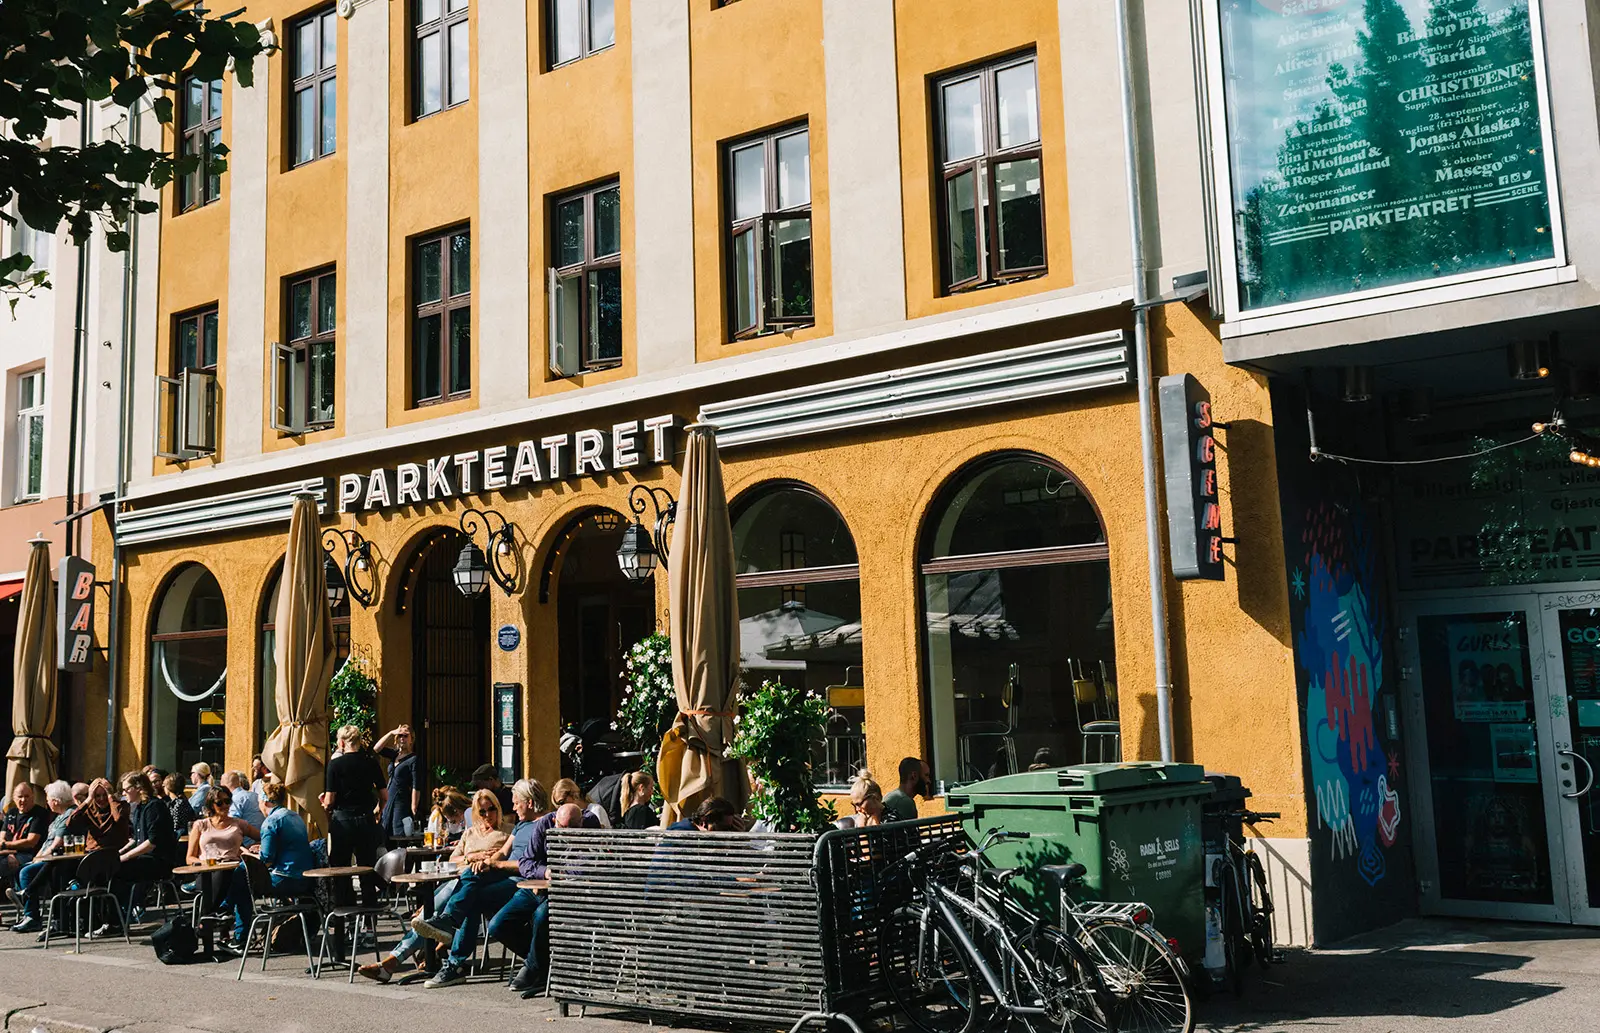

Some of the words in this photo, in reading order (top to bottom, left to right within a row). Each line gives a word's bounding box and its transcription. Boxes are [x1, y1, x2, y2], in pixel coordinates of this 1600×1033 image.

[1387, 54, 1400, 64] 20.
[1402, 44, 1453, 61] september
[1467, 21, 1528, 45] Slippkonsert
[1396, 23, 1457, 46] Bihop
[1274, 55, 1322, 76] Alfred
[1427, 44, 1487, 67] Farida
[1397, 62, 1525, 104] CHRISTEENE
[1425, 73, 1440, 83] 22.
[1441, 62, 1494, 80] september
[1328, 99, 1368, 118] Than
[1404, 100, 1430, 112] Supp:
[1432, 81, 1519, 105] Whalesharkattacks
[1351, 108, 1369, 119] (UK)
[1399, 123, 1435, 138] Yngling
[1436, 118, 1453, 131] (fri
[1454, 112, 1485, 127] alder)
[1495, 105, 1517, 117] over
[1518, 101, 1530, 111] 18
[1428, 112, 1443, 121] 28.
[1445, 101, 1498, 118] september
[1303, 138, 1371, 160] Furubotn,
[1306, 133, 1353, 148] september
[1406, 130, 1457, 154] Jonas
[1459, 117, 1521, 140] Alaska
[1418, 143, 1461, 156] m/David
[1462, 130, 1514, 148] Wallumrød
[1266, 161, 1310, 182] Slfrid
[1312, 149, 1367, 171] Molland
[1367, 146, 1383, 158] &
[1292, 170, 1333, 188] Roger
[1334, 156, 1391, 179] Aadland
[1434, 161, 1503, 183] Masego
[1501, 153, 1519, 165] (US)
[1442, 159, 1452, 168] 3.
[1453, 152, 1494, 166] oktober
[1277, 189, 1376, 218] Zeromancer
[1309, 184, 1358, 200] september
[1330, 194, 1472, 235] PARKTEATRET
[1511, 184, 1540, 196] SCENE
[339, 413, 674, 514] PARKTEATRET
[1194, 401, 1221, 563] SCENE
[69, 571, 94, 664] BAR
[1139, 842, 1157, 857] RAGN
[1163, 838, 1180, 853] SELLS
